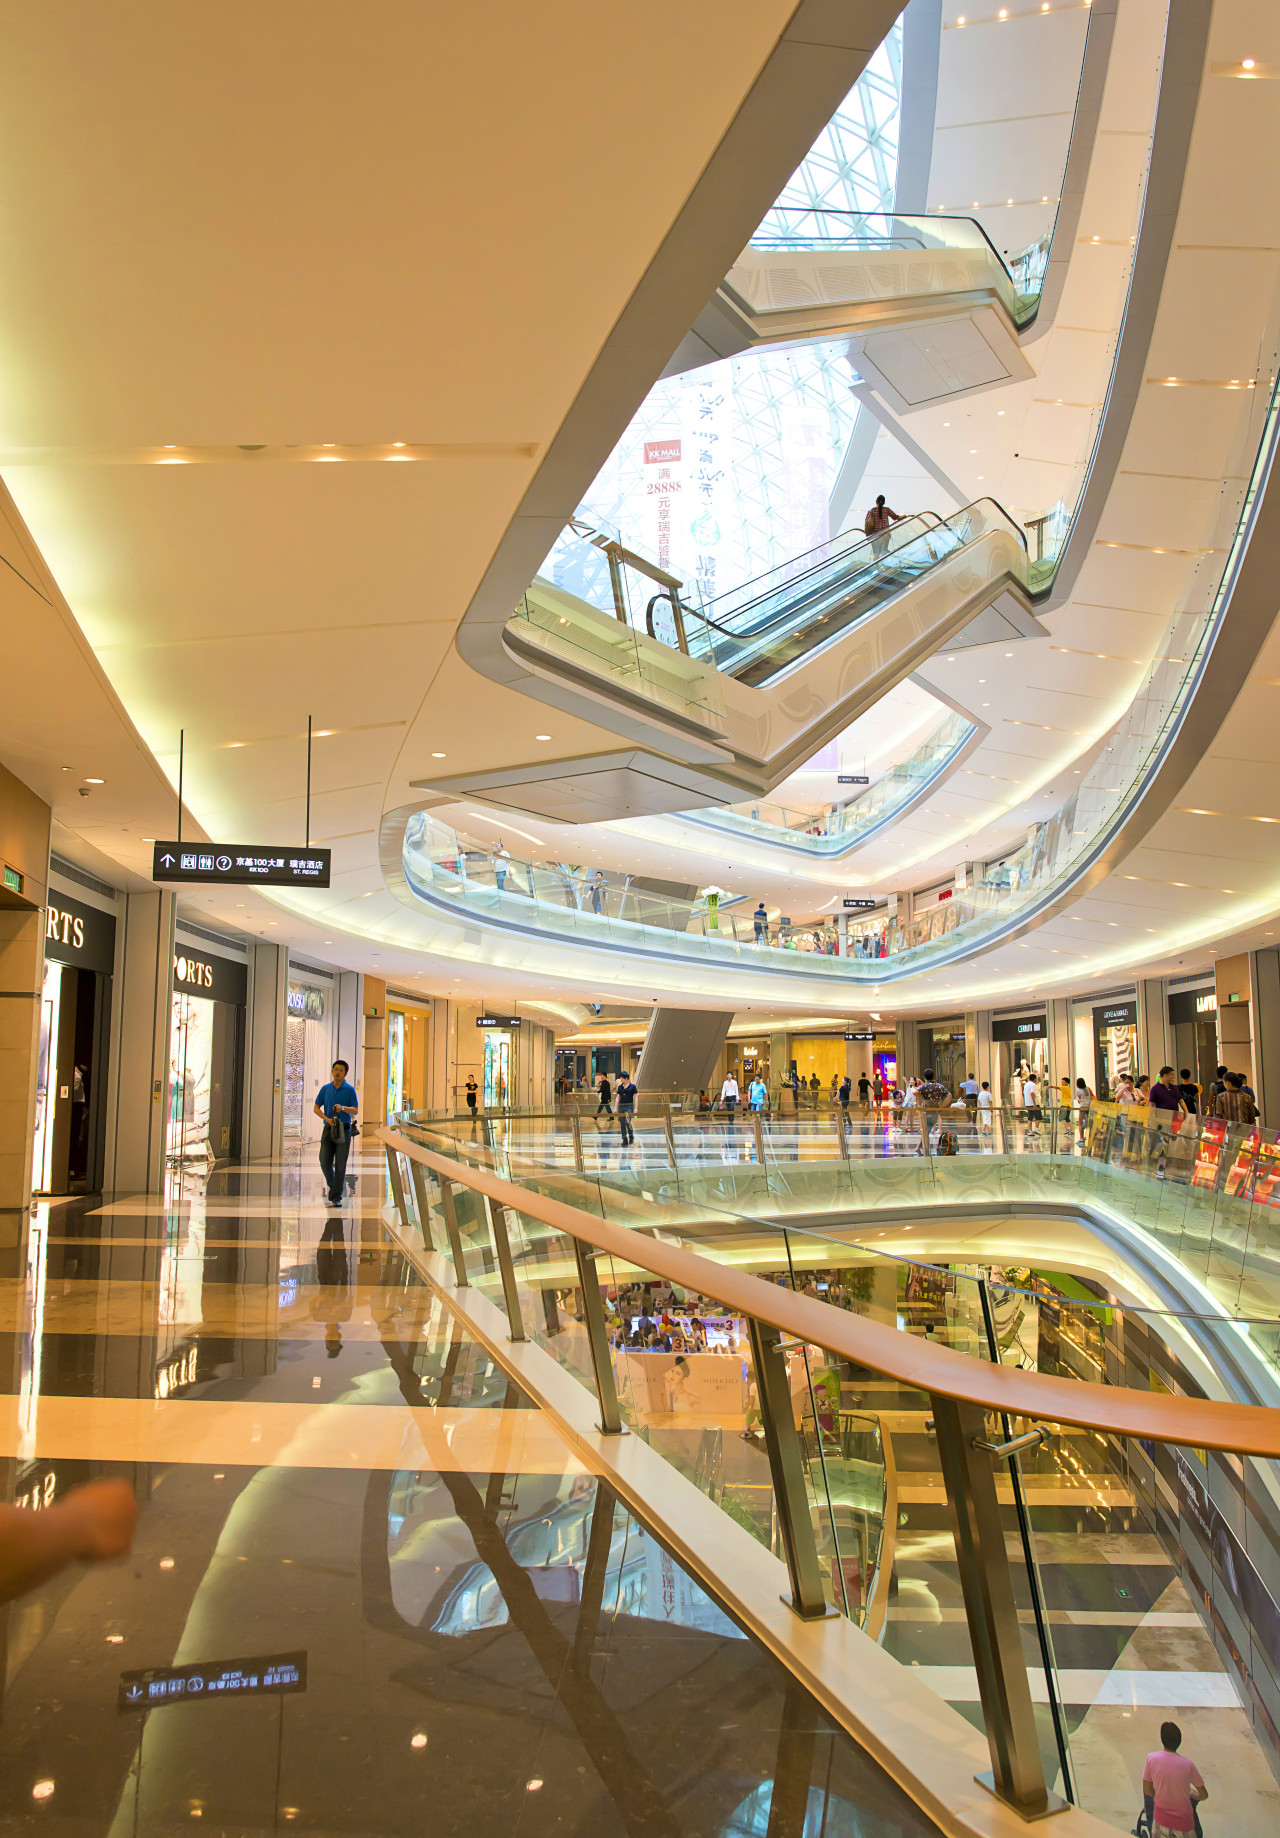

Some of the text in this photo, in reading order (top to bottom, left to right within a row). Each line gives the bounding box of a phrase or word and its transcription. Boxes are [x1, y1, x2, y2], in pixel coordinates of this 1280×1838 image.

[649, 449, 680, 458] KK MALL
[658, 468, 671, 479] 满
[236, 857, 324, 870] 京基100大厦 瑞吉酒店
